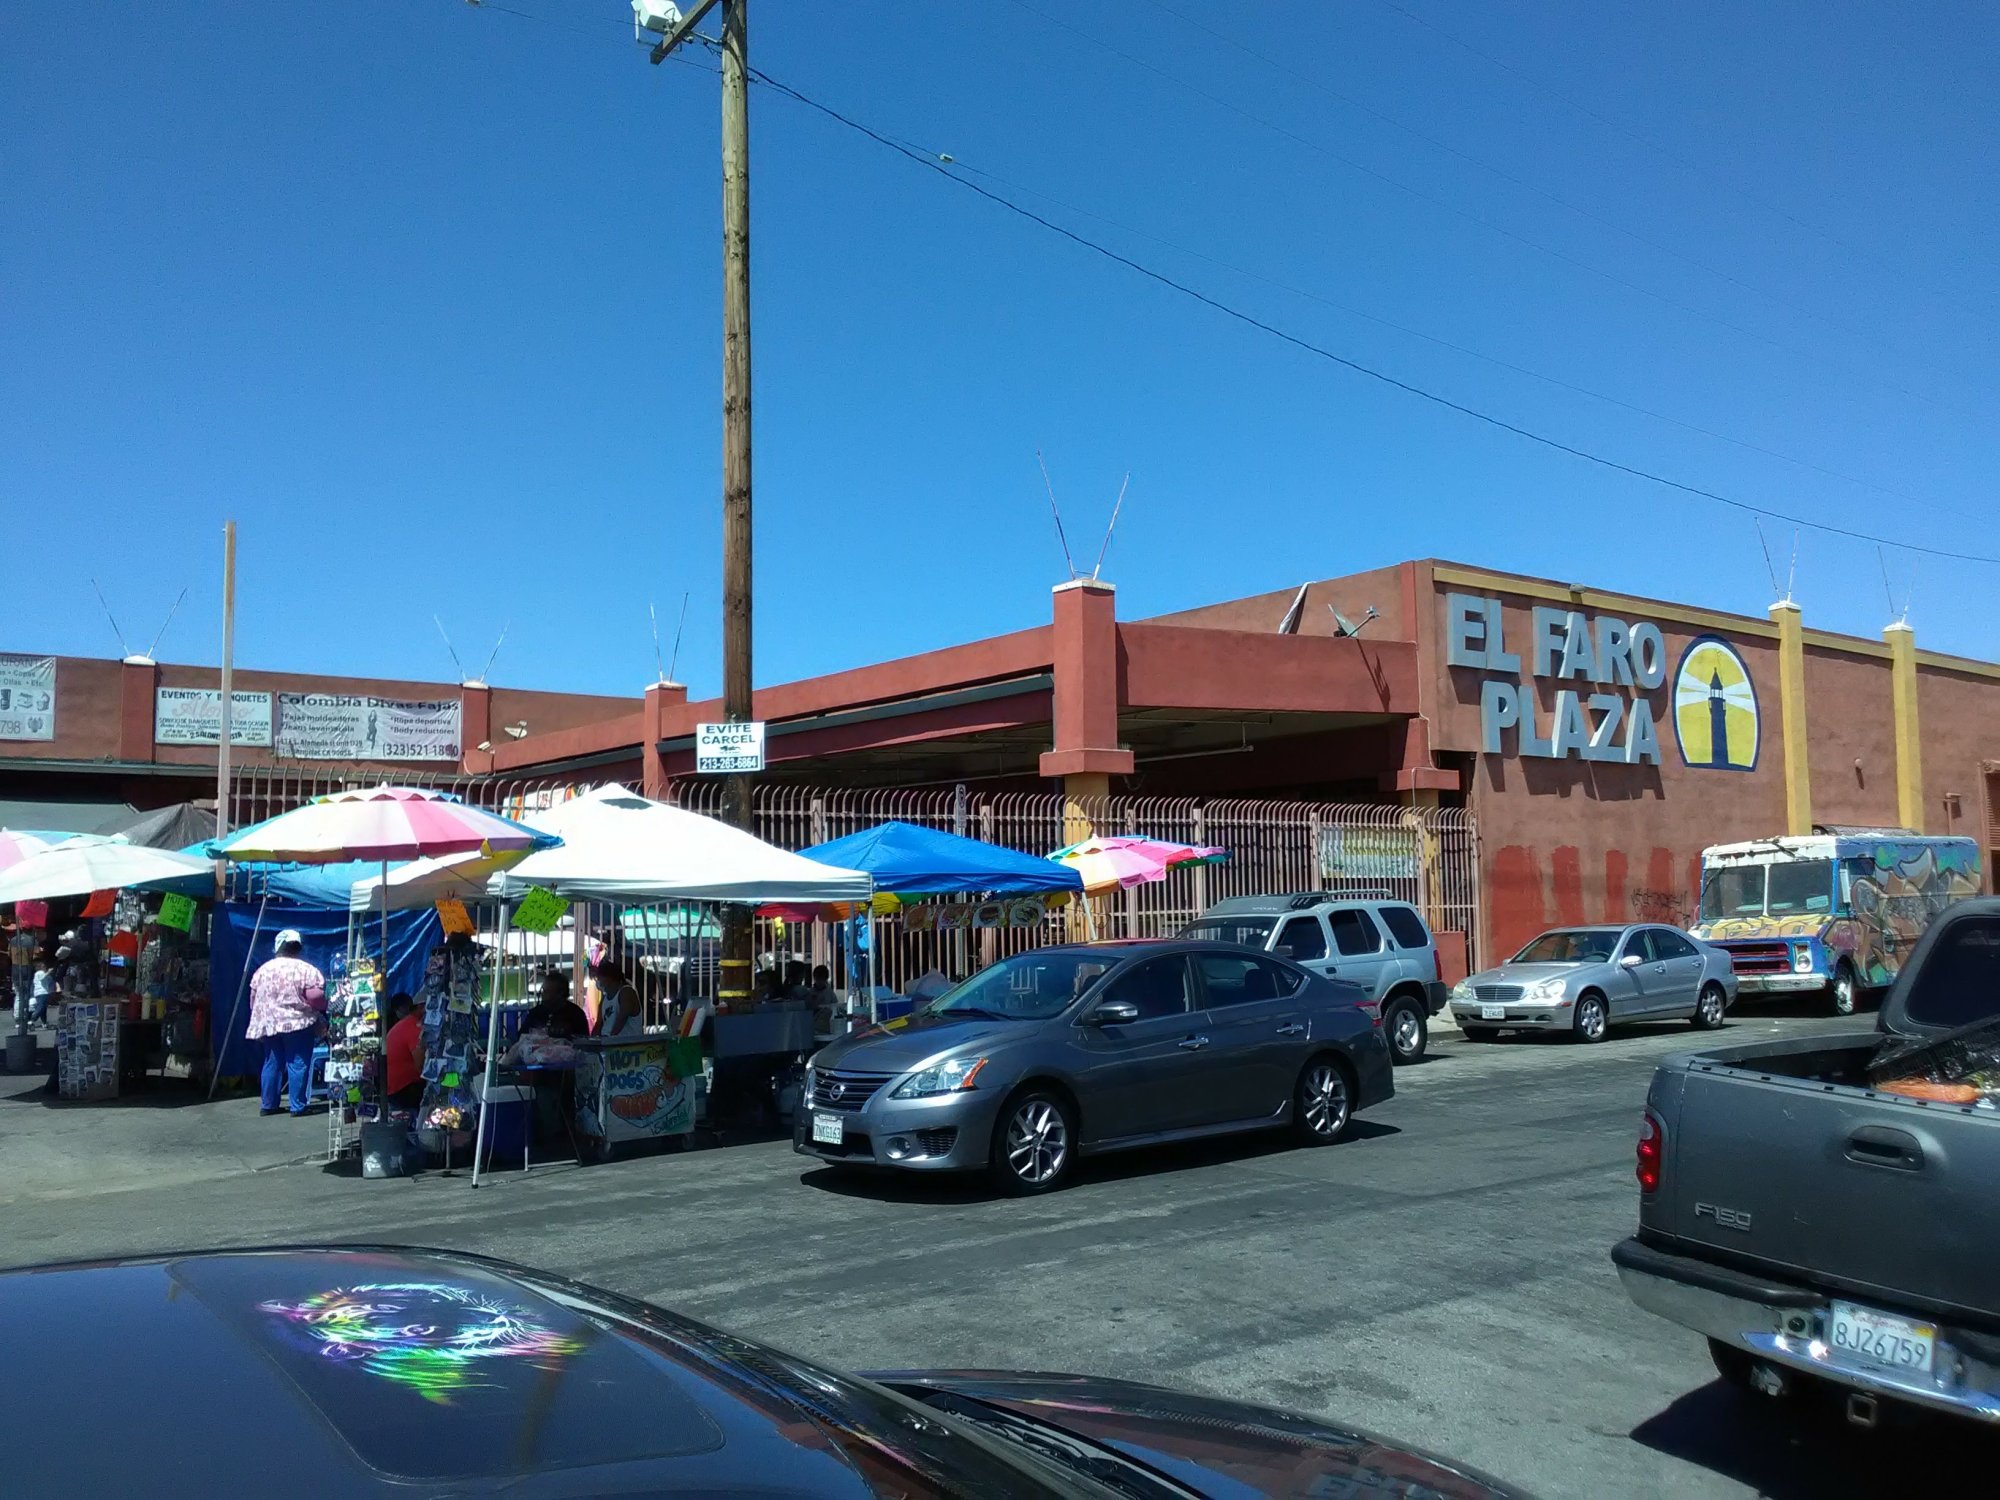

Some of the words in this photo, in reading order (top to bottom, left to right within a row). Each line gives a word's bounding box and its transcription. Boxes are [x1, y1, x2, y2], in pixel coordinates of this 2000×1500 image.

[1446, 592, 1521, 673] EL
[1532, 606, 1666, 690] FARO
[161, 690, 202, 701] EVENTOS
[205, 692, 213, 701] Y
[217, 693, 268, 704] BNQUETES
[278, 693, 362, 707] Colombia
[367, 697, 416, 709] Divas
[417, 701, 459, 712] Fajas
[415, 717, 452, 726] deportiva
[415, 726, 455, 735] reductores
[706, 724, 752, 734] EVITE
[1481, 680, 1662, 766] PLAZA
[701, 734, 756, 745] CARCEL
[609, 1049, 641, 1071] HOT
[606, 1070, 645, 1090] DOGS
[1694, 1202, 1752, 1227] F150
[1836, 1322, 1927, 1368] 8J26759
